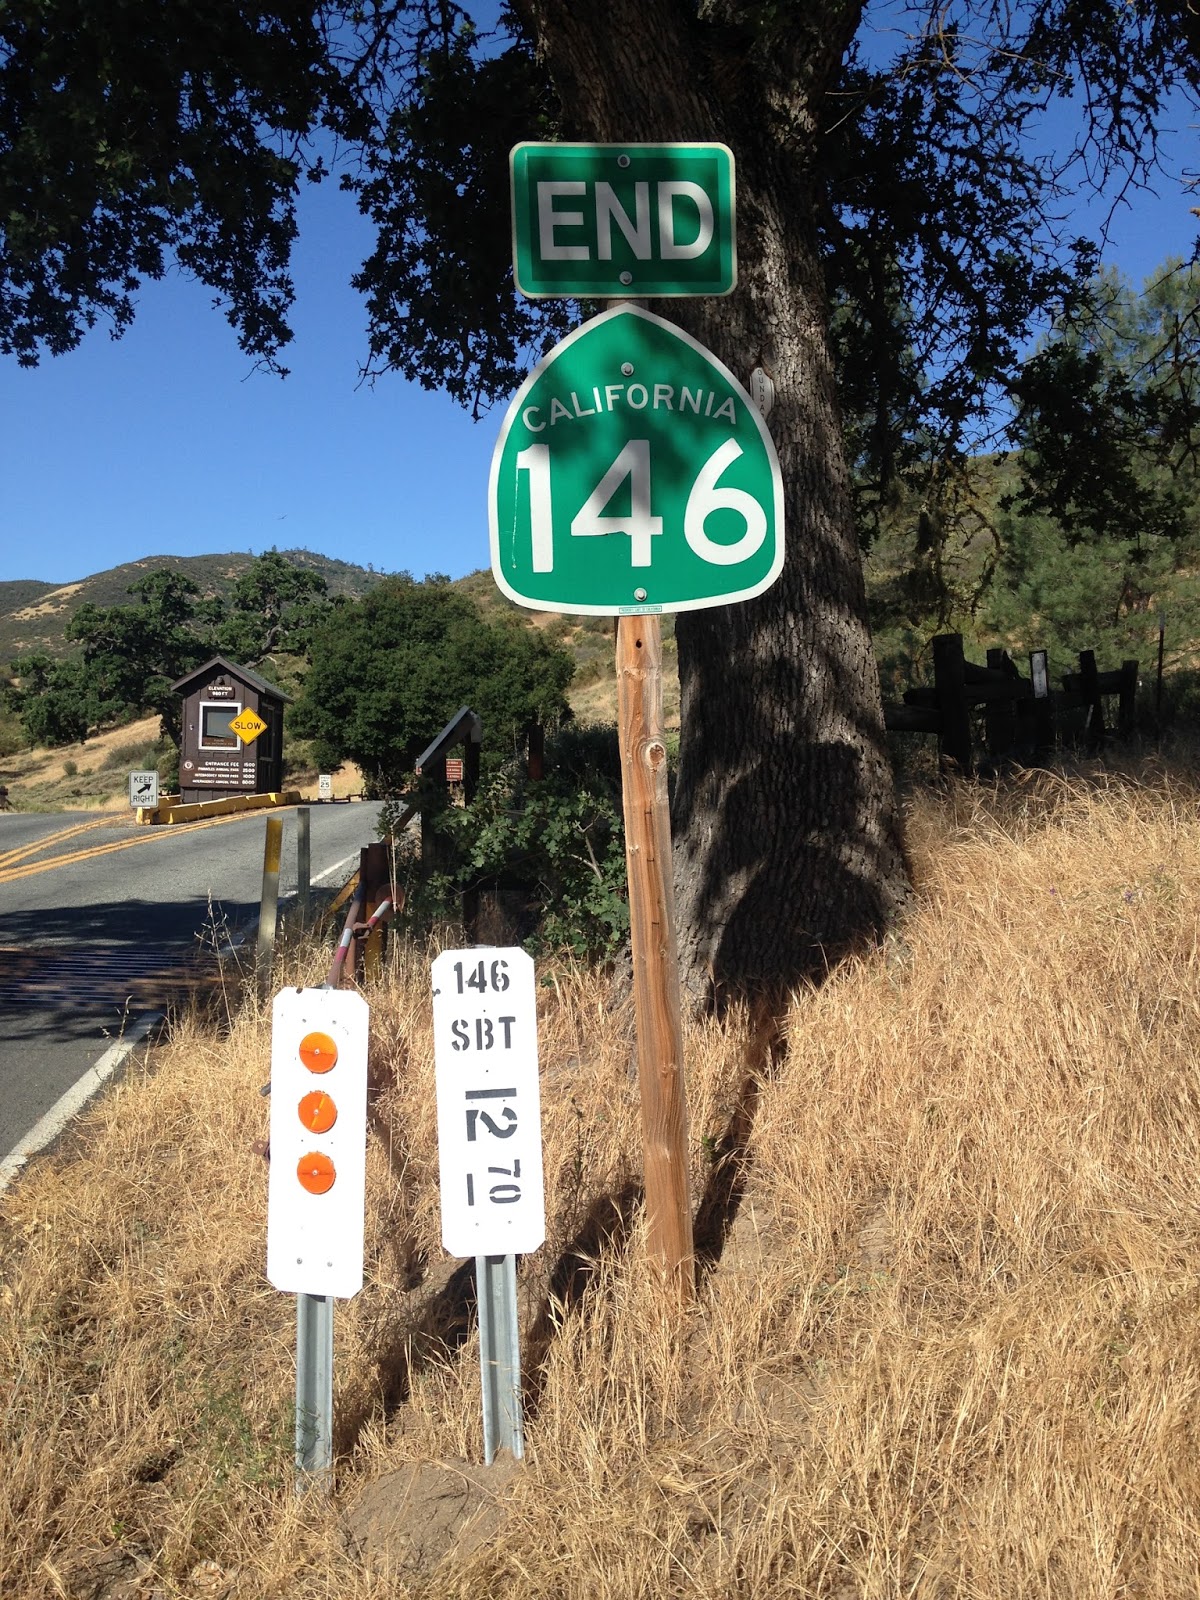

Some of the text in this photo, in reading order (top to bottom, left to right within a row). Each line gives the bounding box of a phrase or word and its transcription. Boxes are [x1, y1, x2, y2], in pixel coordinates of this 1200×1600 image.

[537, 181, 714, 260] END
[522, 383, 737, 433] CALIFORNIA
[517, 438, 767, 573] 146
[234, 721, 261, 730] SLOW
[453, 959, 510, 994] 146
[451, 1016, 516, 1051] SBT
